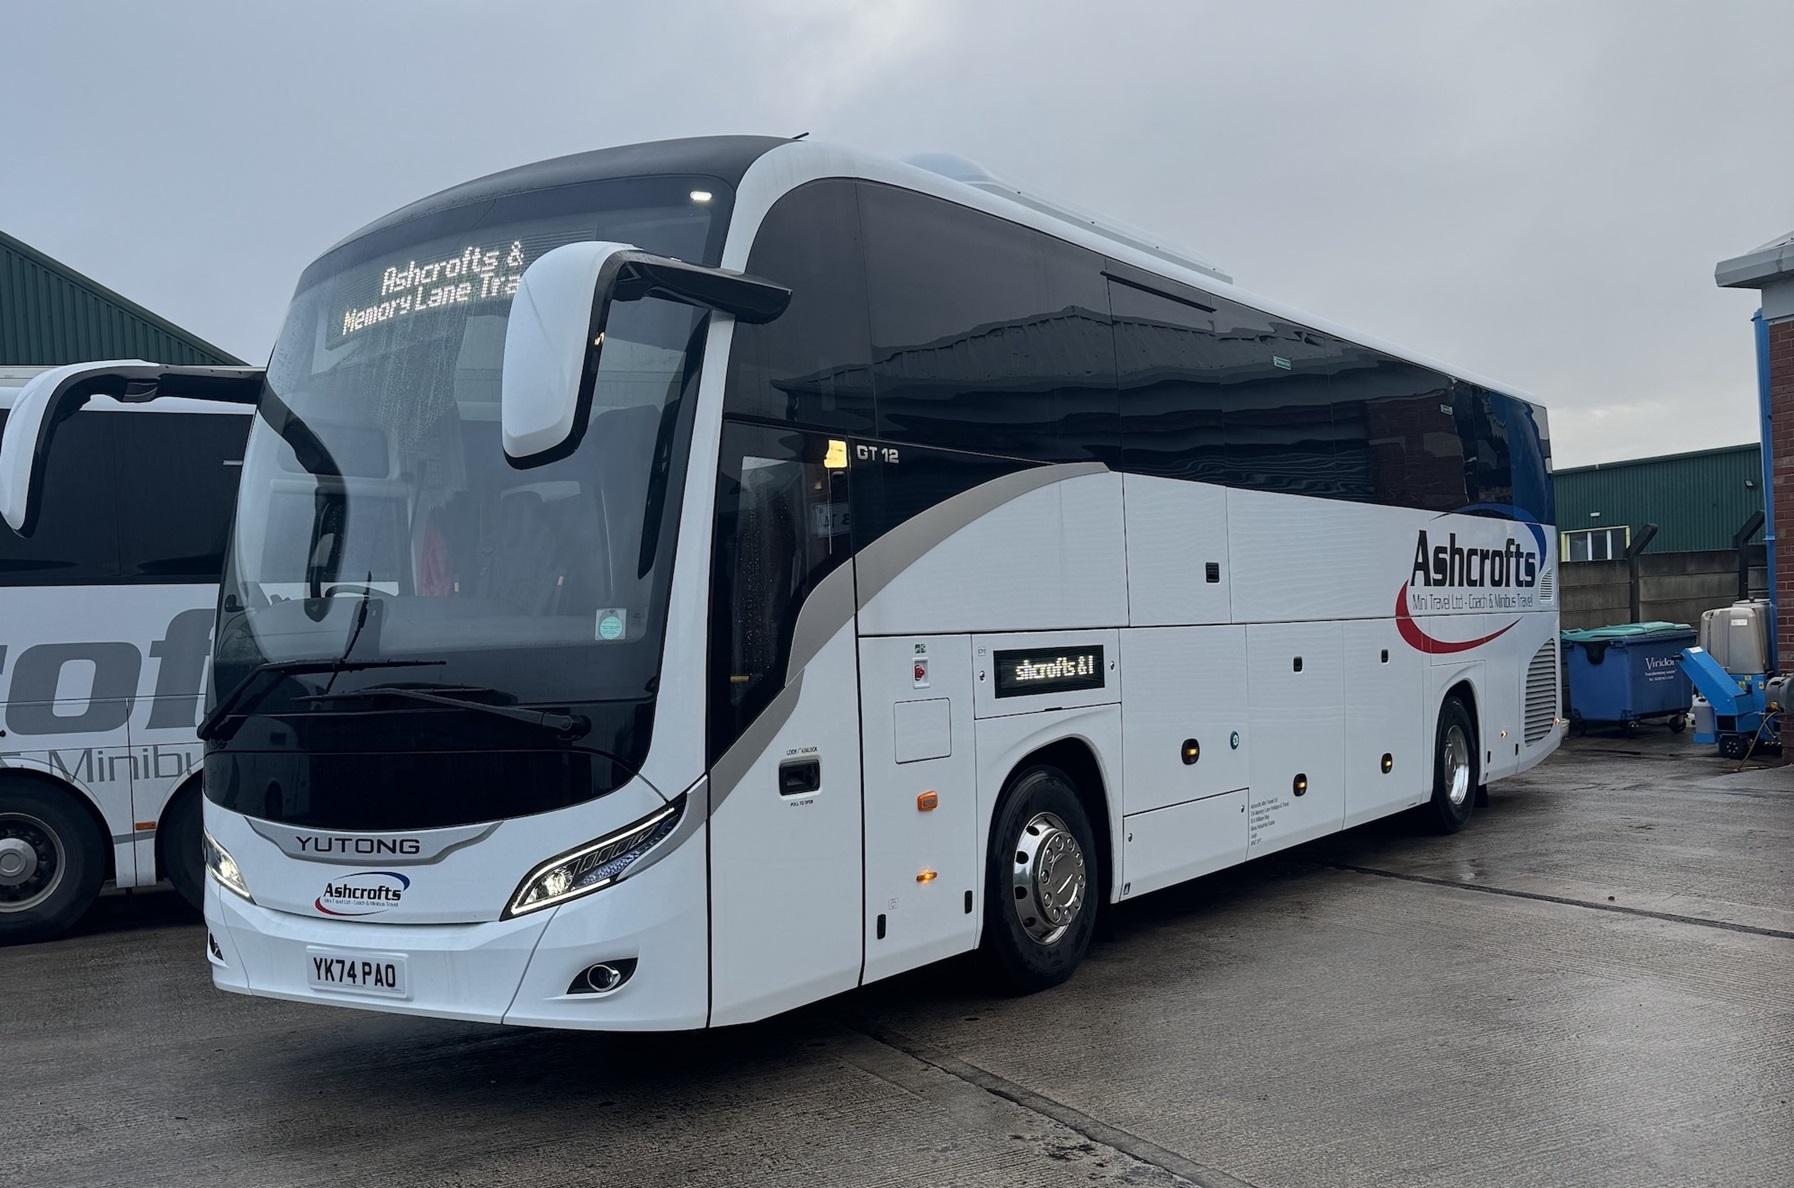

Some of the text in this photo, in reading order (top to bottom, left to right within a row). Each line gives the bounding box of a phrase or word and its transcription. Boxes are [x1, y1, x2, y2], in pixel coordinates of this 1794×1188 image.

[381, 240, 525, 296] Ashcrofts &
[342, 293, 412, 336] Memory
[415, 282, 472, 311] Lane
[856, 444, 899, 464] GT 12
[1410, 529, 1536, 588] Ashcrofts
[1412, 593, 1428, 610] Mini
[1429, 593, 1451, 610] Travel
[1451, 593, 1464, 610] Ltd
[1469, 593, 1488, 609] Coach
[1494, 593, 1516, 609] Minibus
[1516, 593, 1533, 608] Travel
[1077, 655, 1087, 675] &
[295, 836, 421, 854] YUTONG
[323, 882, 402, 901] Ashcrofts
[313, 957, 397, 988] YK74 PAO
